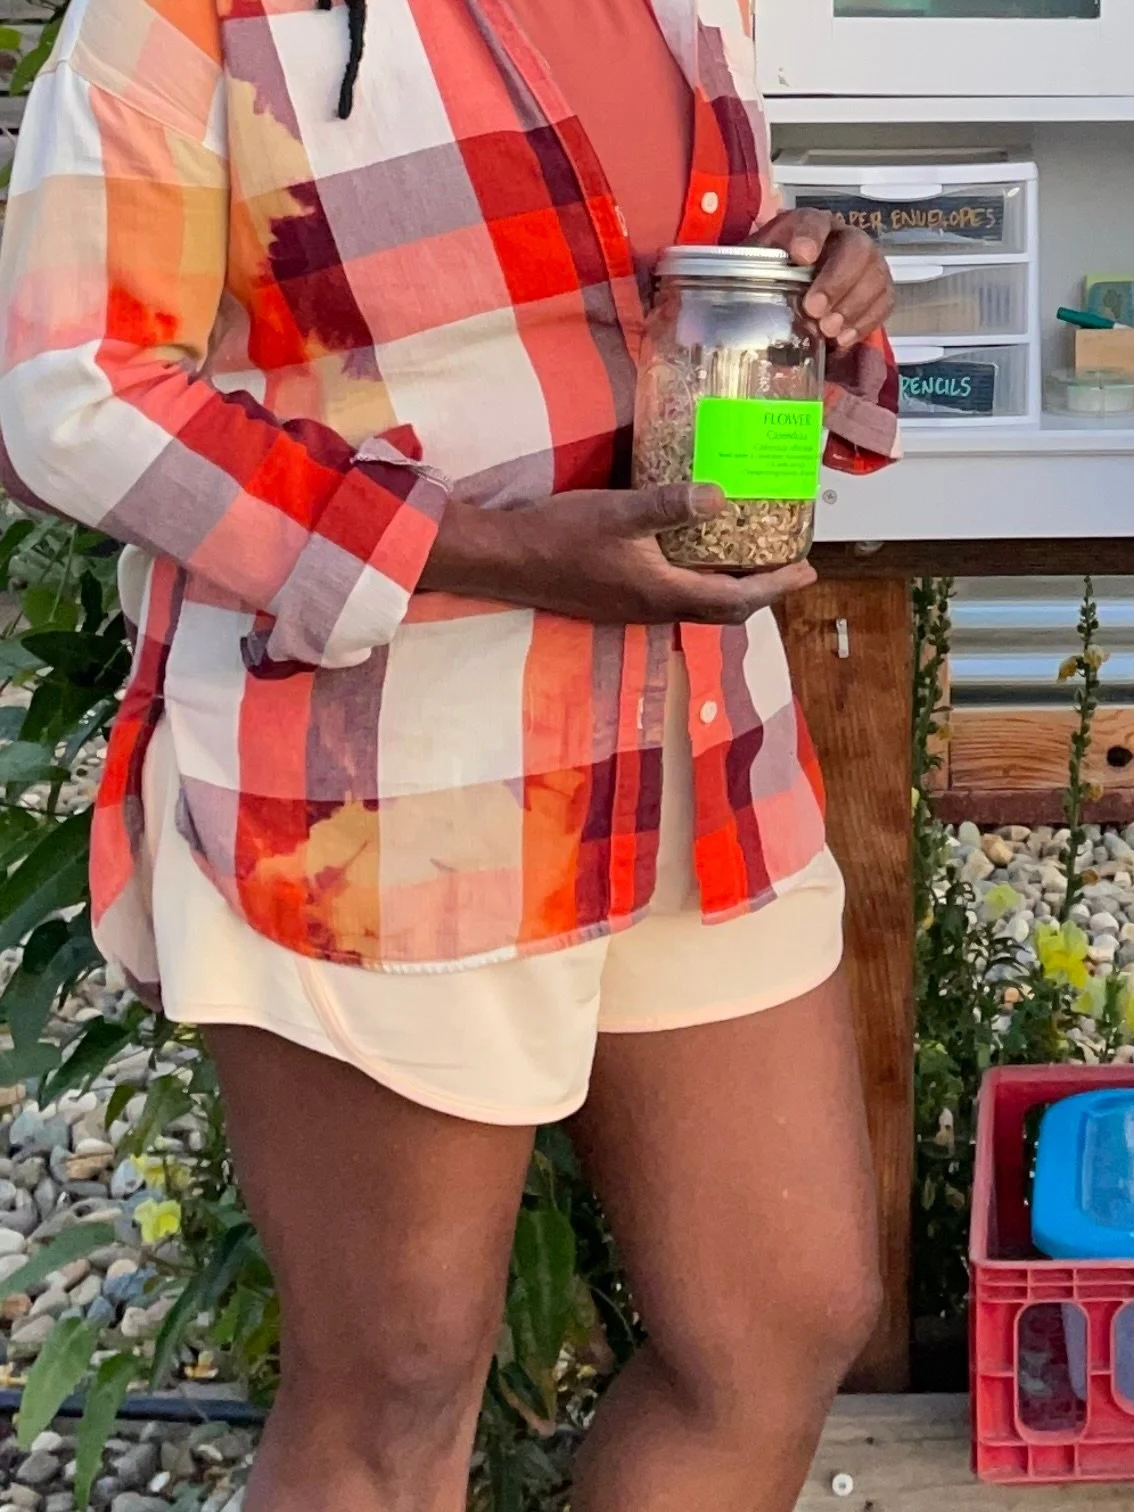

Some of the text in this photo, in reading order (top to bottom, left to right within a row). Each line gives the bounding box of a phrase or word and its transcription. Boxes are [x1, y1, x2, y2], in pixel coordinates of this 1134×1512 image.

[834, 207, 887, 229] APER
[899, 374, 972, 400] PENCILS
[763, 412, 812, 426] FLOWER
